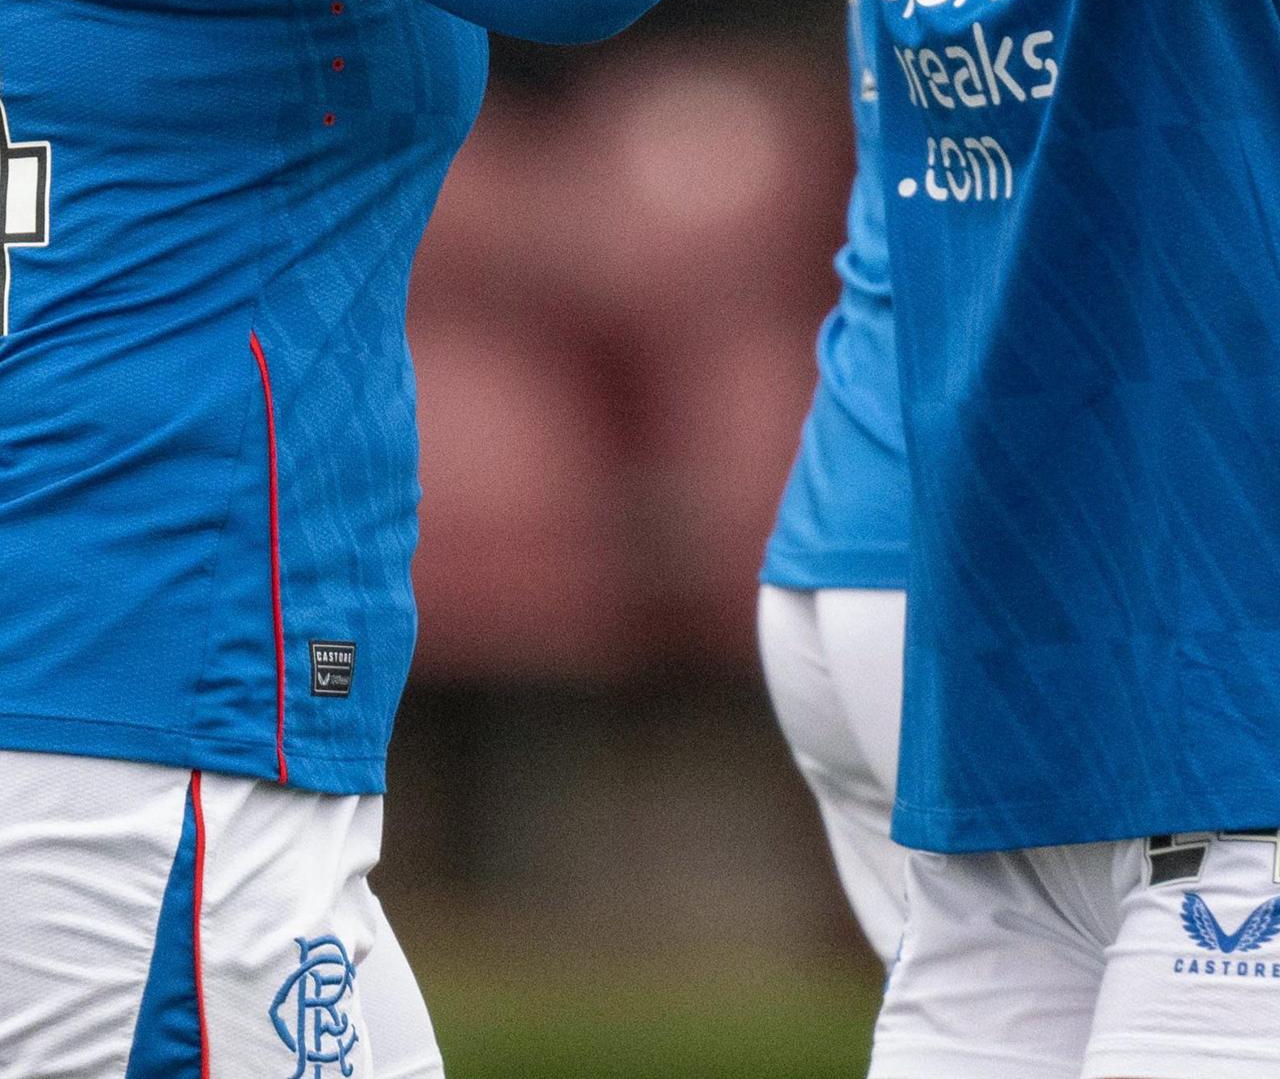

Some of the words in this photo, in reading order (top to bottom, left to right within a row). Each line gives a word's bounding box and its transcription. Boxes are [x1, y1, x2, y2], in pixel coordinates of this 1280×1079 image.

[892, 21, 1059, 110] reaks
[897, 135, 1013, 202] .com
[316, 651, 352, 663] CASTORE
